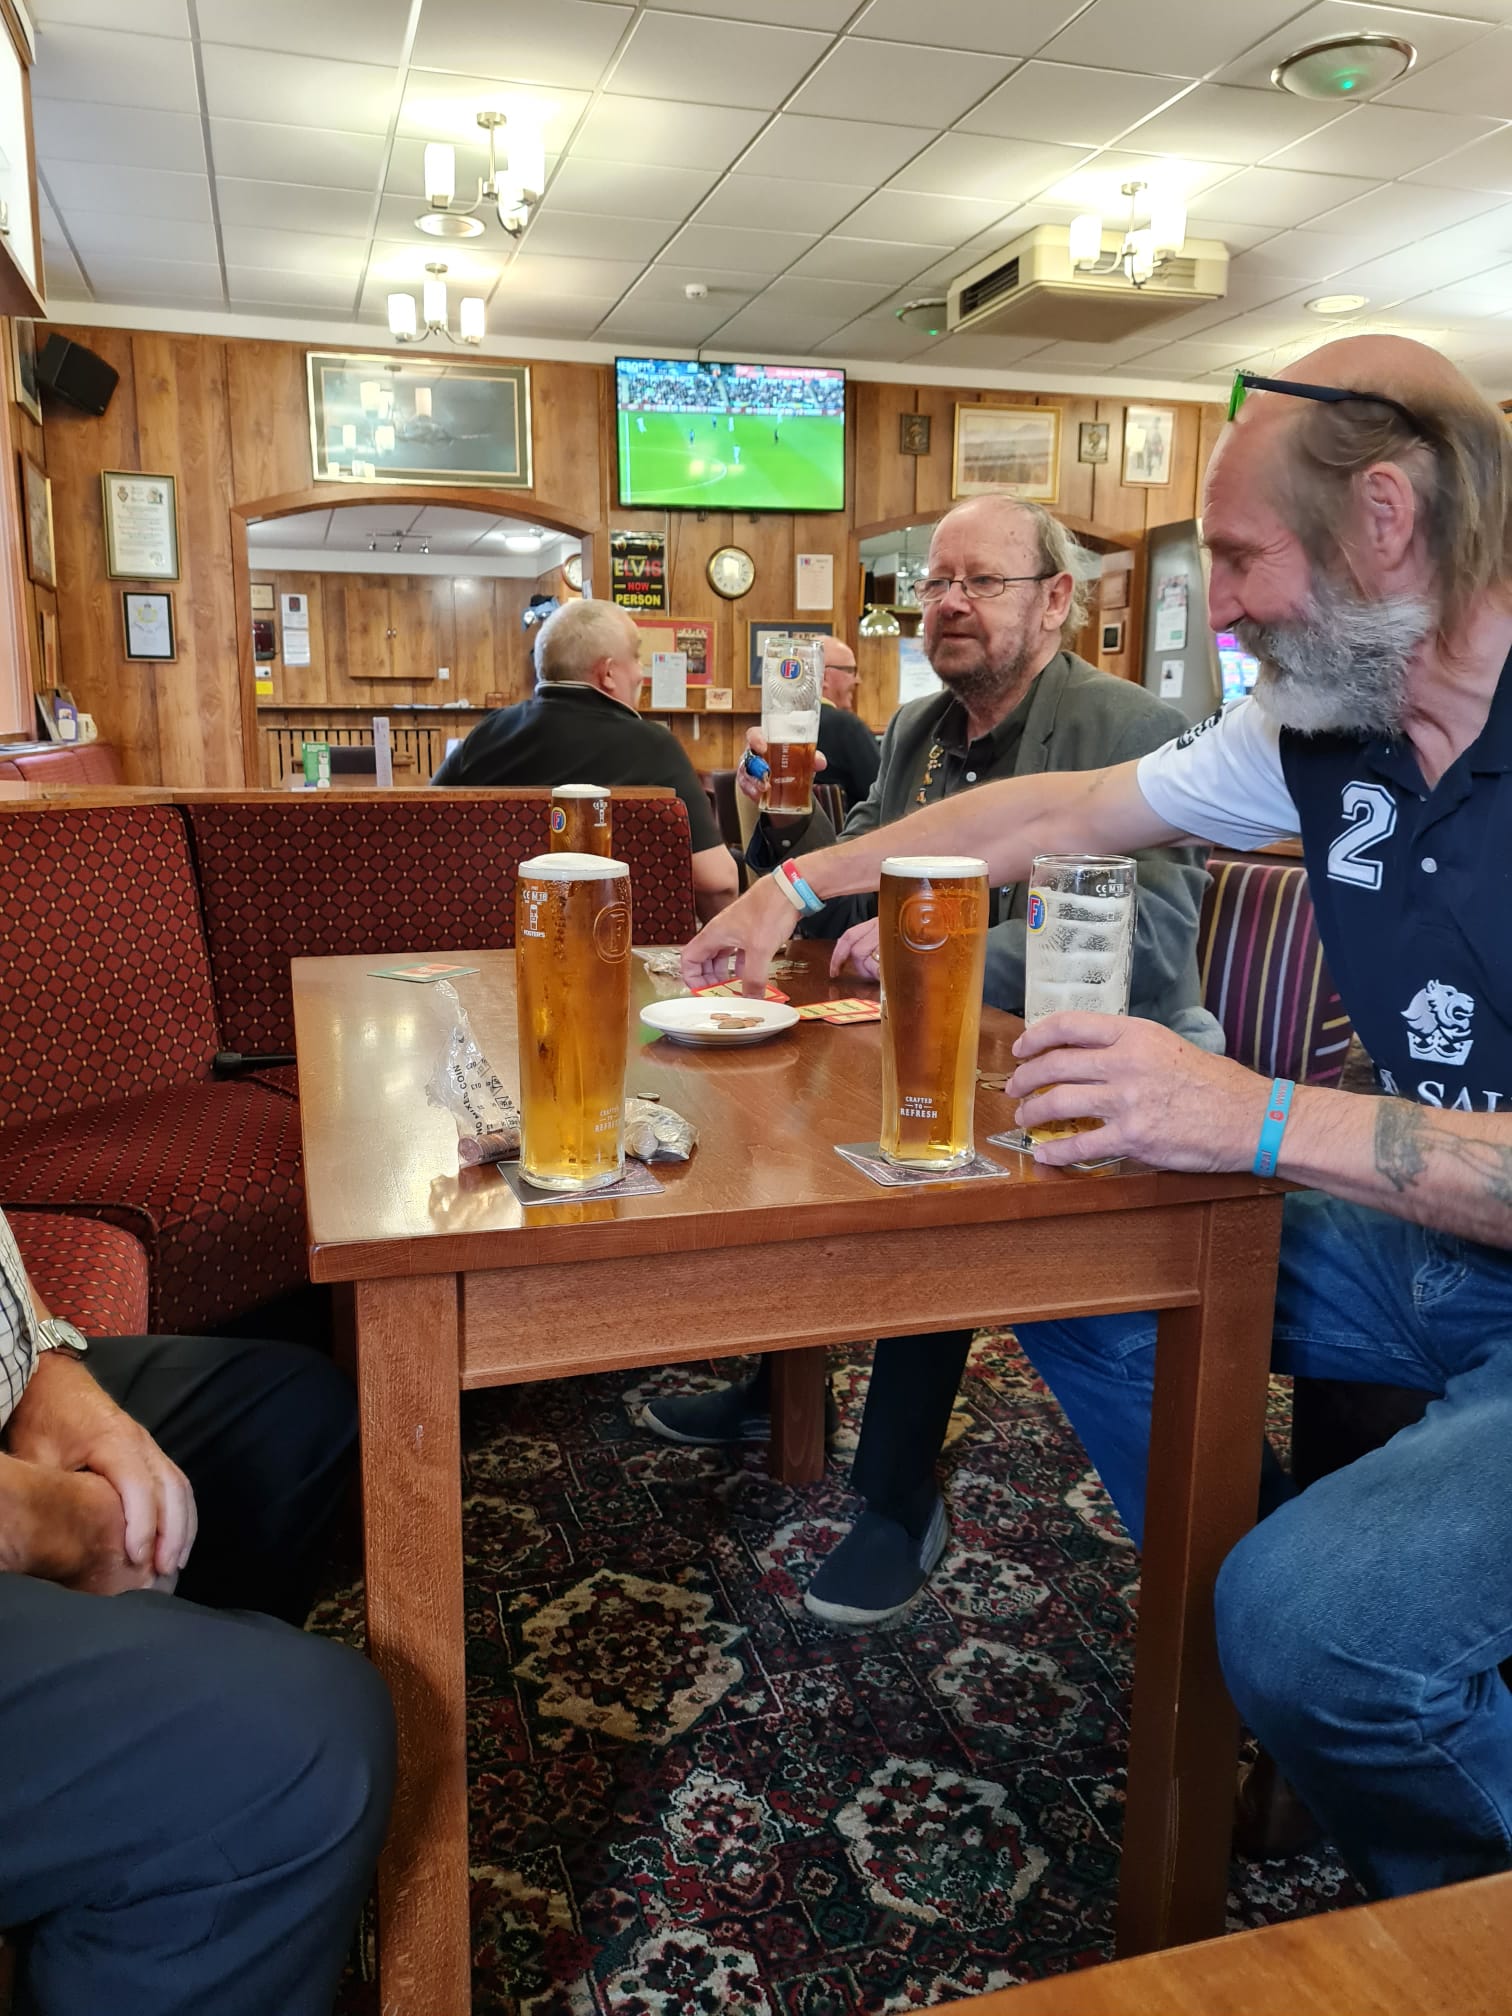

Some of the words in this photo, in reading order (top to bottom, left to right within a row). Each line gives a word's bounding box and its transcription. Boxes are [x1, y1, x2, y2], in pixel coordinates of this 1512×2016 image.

[614, 558, 661, 577] ELVIS
[615, 594, 661, 606] PERSON
[1327, 780, 1397, 890] 2
[1096, 884, 1107, 893] CE
[453, 1064, 467, 1090] COIN
[905, 1096, 933, 1104] CRAFTED
[900, 1108, 937, 1118] REFRESH
[475, 1121, 483, 1136] NO
